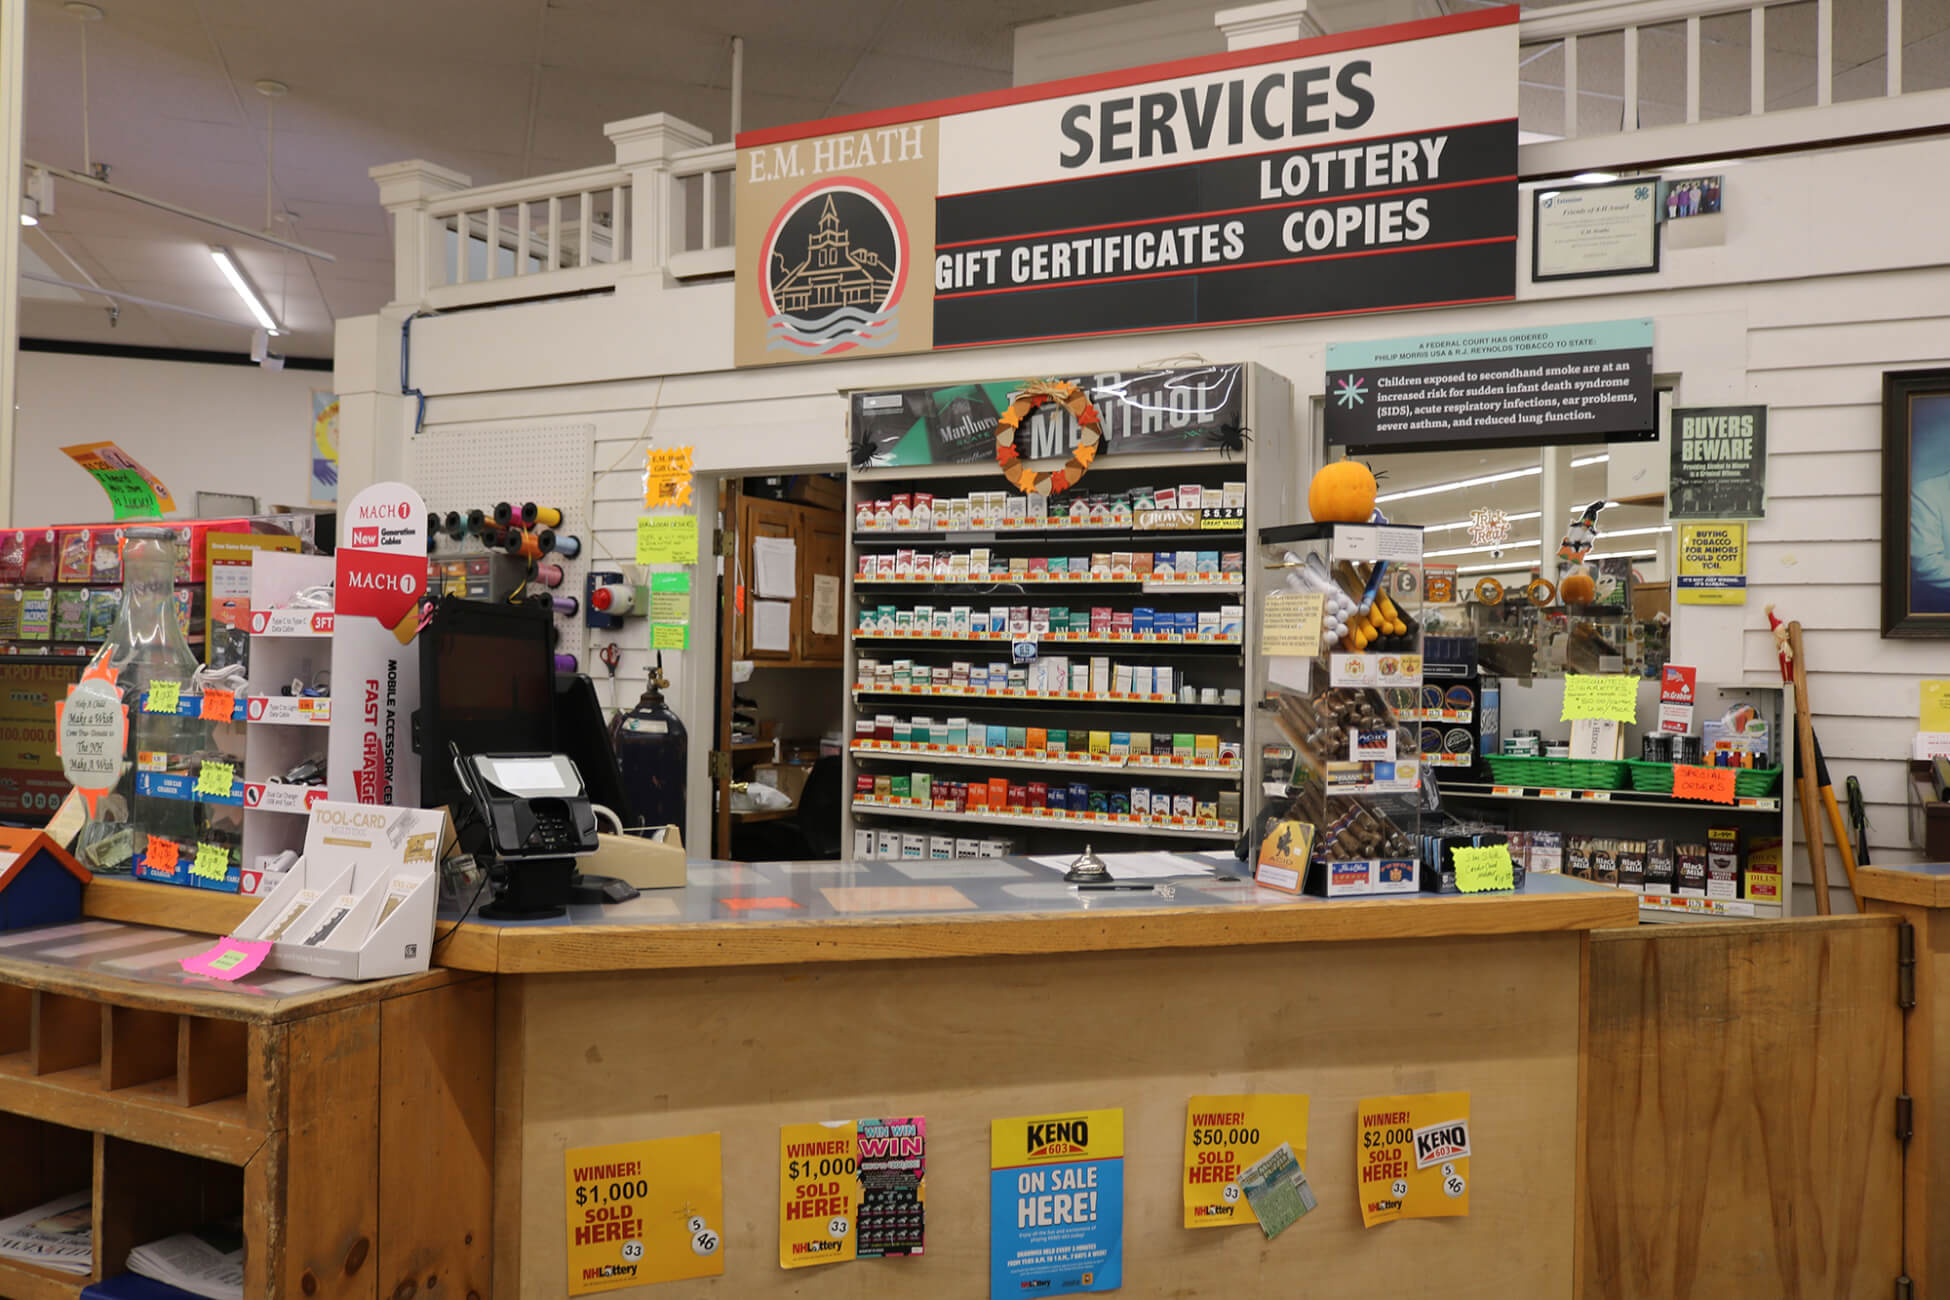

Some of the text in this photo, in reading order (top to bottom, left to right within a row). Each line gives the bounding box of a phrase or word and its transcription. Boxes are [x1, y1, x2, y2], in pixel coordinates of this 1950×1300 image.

[1059, 60, 1375, 168] SERVICES
[749, 125, 924, 183] E.M. HEATH
[1260, 135, 1448, 200] LOTTERY
[1282, 198, 1431, 253] COPIES
[934, 221, 1245, 291] GIFT CERTIFICATES
[1425, 340, 1461, 348] FEDERAL
[1462, 338, 1489, 346] COURT
[1491, 336, 1509, 344] HAS
[1509, 333, 1548, 342] ORDERED
[1374, 353, 1398, 361] PHILIP
[1399, 351, 1429, 360] MORRIS
[1430, 349, 1446, 357] USA
[1470, 345, 1513, 354] REYNOLDS
[1515, 341, 1554, 351] TOBACCO
[1377, 362, 1630, 387] Children exposed to secondhand smoke are at an
[1377, 377, 1630, 402] increased risk for sudden infant death syndrome
[1377, 392, 1637, 419] (SIDS), acute respiratory infections, ear problems,
[940, 415, 998, 443] Marlboro
[1377, 409, 1596, 431] severe asthma, and reduced lung function.
[1682, 415, 1753, 439] BUYERS
[1682, 438, 1753, 462] BEWARE
[359, 503, 396, 519] MACH
[1139, 510, 1195, 527] CROWNS
[353, 528, 415, 545] New Generation
[381, 537, 401, 545] Cables
[1692, 538, 1731, 546] TOBACCO
[1696, 530, 1728, 538] BUYING
[348, 570, 398, 591] MACH
[314, 617, 333, 629] 3FT
[39, 665, 78, 681] ALERT
[386, 659, 397, 706] MOBILE
[69, 712, 87, 724] Make
[95, 711, 114, 724] Wish
[76, 739, 89, 752] The
[362, 679, 379, 805] FAST CHARGE
[384, 709, 395, 782] ACCESSORY
[95, 757, 113, 769] Wish
[315, 808, 387, 830] TOOL-CARD
[1621, 858, 1641, 867] Black
[1625, 864, 1643, 873] Mild
[1683, 862, 1703, 871] Black
[1685, 867, 1704, 877] Mild
[1192, 1112, 1245, 1127] WINNER!
[1363, 1111, 1410, 1128] WINNER!
[863, 1124, 917, 1138] WIN WIN
[1027, 1120, 1088, 1154] KENO
[1193, 1128, 1260, 1148] $50,000
[1364, 1128, 1414, 1149] $2,000
[787, 1140, 849, 1159] WINNER!
[859, 1136, 923, 1158] WIN
[1048, 1143, 1068, 1154] 603
[1417, 1126, 1466, 1158] KENO
[1435, 1146, 1451, 1157] 603
[1198, 1151, 1234, 1165] SOLD
[1369, 1148, 1402, 1163] SOLD
[573, 1160, 641, 1183] WINNER!
[789, 1158, 856, 1180] $1,000
[1189, 1164, 1241, 1184] HERE!
[1362, 1161, 1408, 1183] HERE!
[1445, 1165, 1451, 1175] 5
[1018, 1166, 1098, 1194] ON SALE
[1393, 1183, 1407, 1194] 33
[1447, 1178, 1463, 1193] 46
[575, 1180, 648, 1207] $1,000
[796, 1182, 840, 1199] SOLD
[1225, 1187, 1238, 1199] 33
[584, 1205, 633, 1224] SOLD
[786, 1196, 849, 1221] HERE!
[1017, 1191, 1098, 1229] HERE!
[575, 1218, 643, 1246] HERE!
[693, 1219, 701, 1231] 5
[831, 1221, 847, 1233] 33
[624, 1244, 641, 1257] 33
[697, 1232, 716, 1251] 46
[792, 1240, 843, 1255] NHLottery
[582, 1264, 638, 1281] NHLottery
